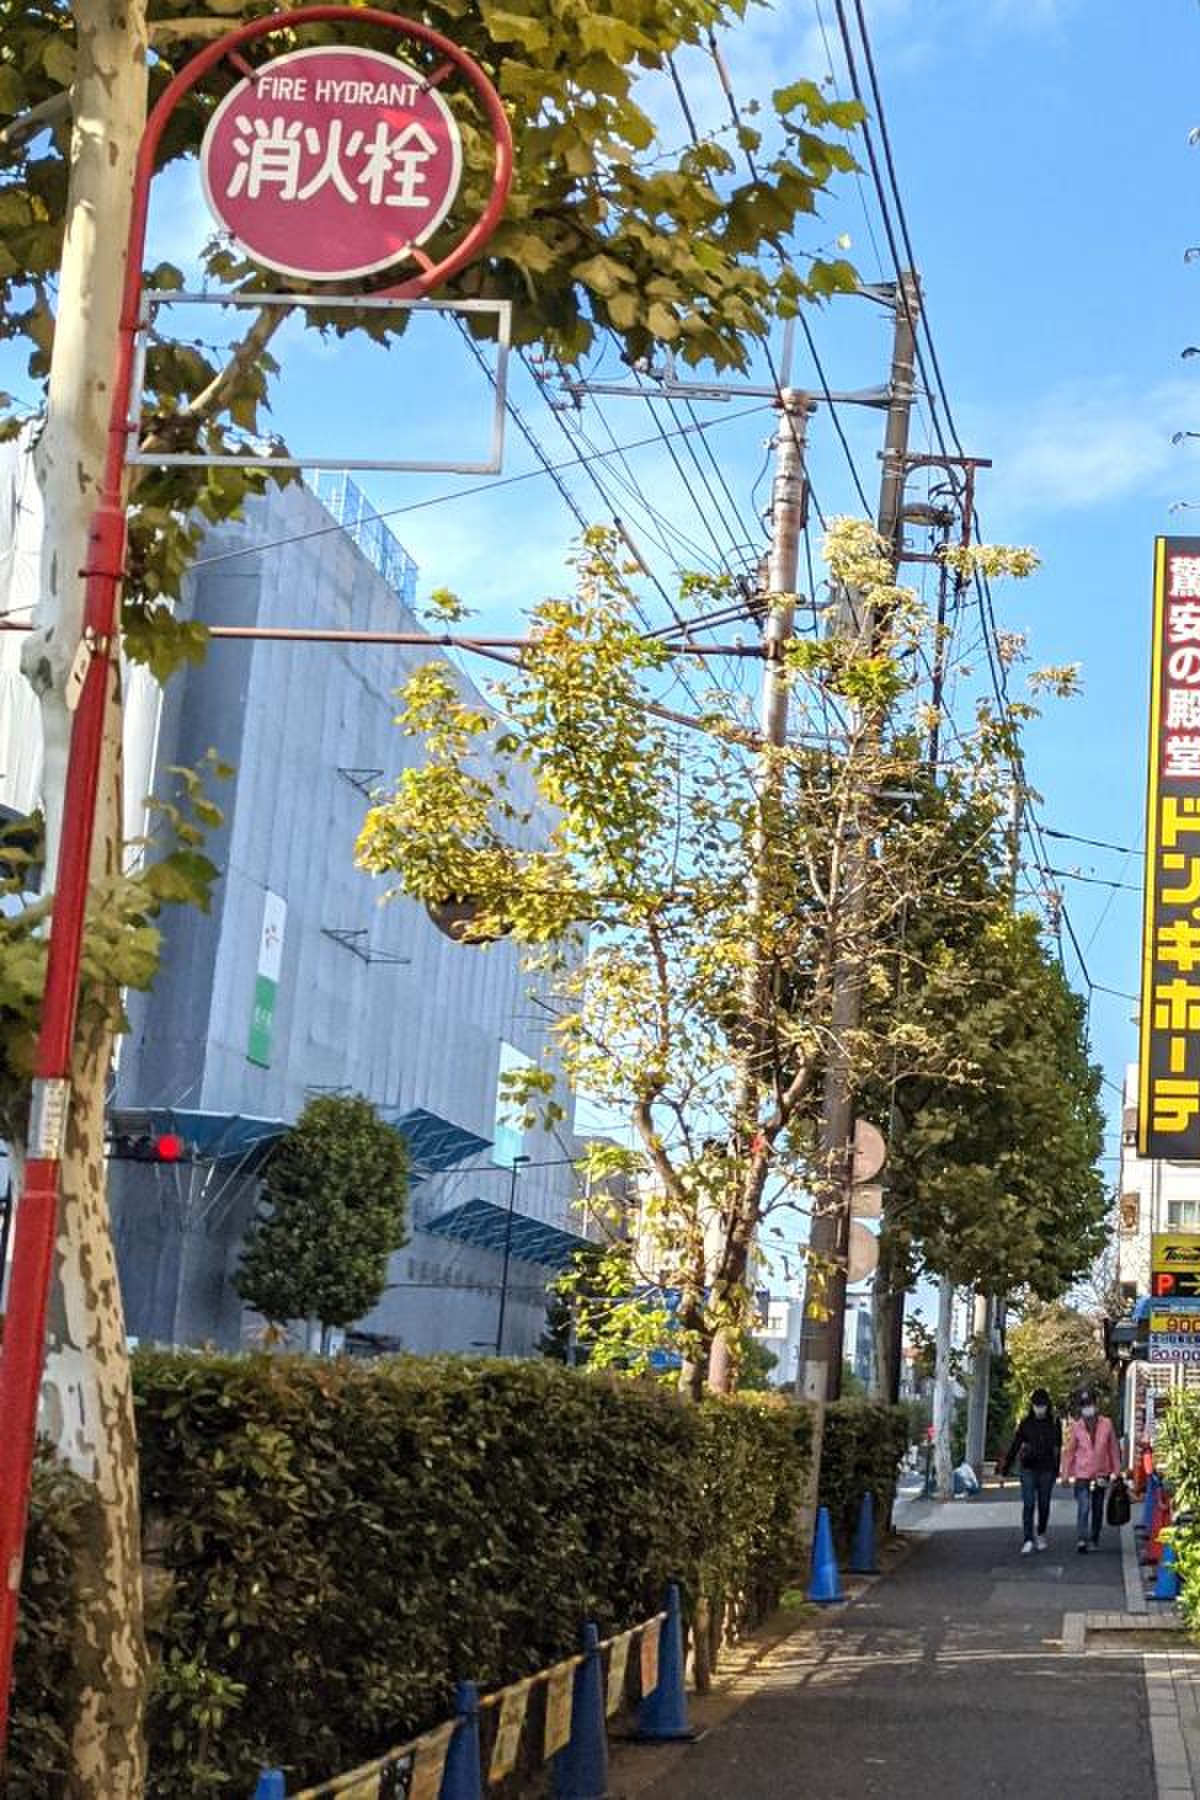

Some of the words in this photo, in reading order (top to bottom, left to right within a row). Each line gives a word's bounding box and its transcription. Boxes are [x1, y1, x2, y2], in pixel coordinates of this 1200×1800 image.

[257, 77, 306, 101] FIRE
[315, 79, 420, 107] HYDRANT
[227, 116, 438, 207] 消火栓
[1158, 1275, 1175, 1296] P
